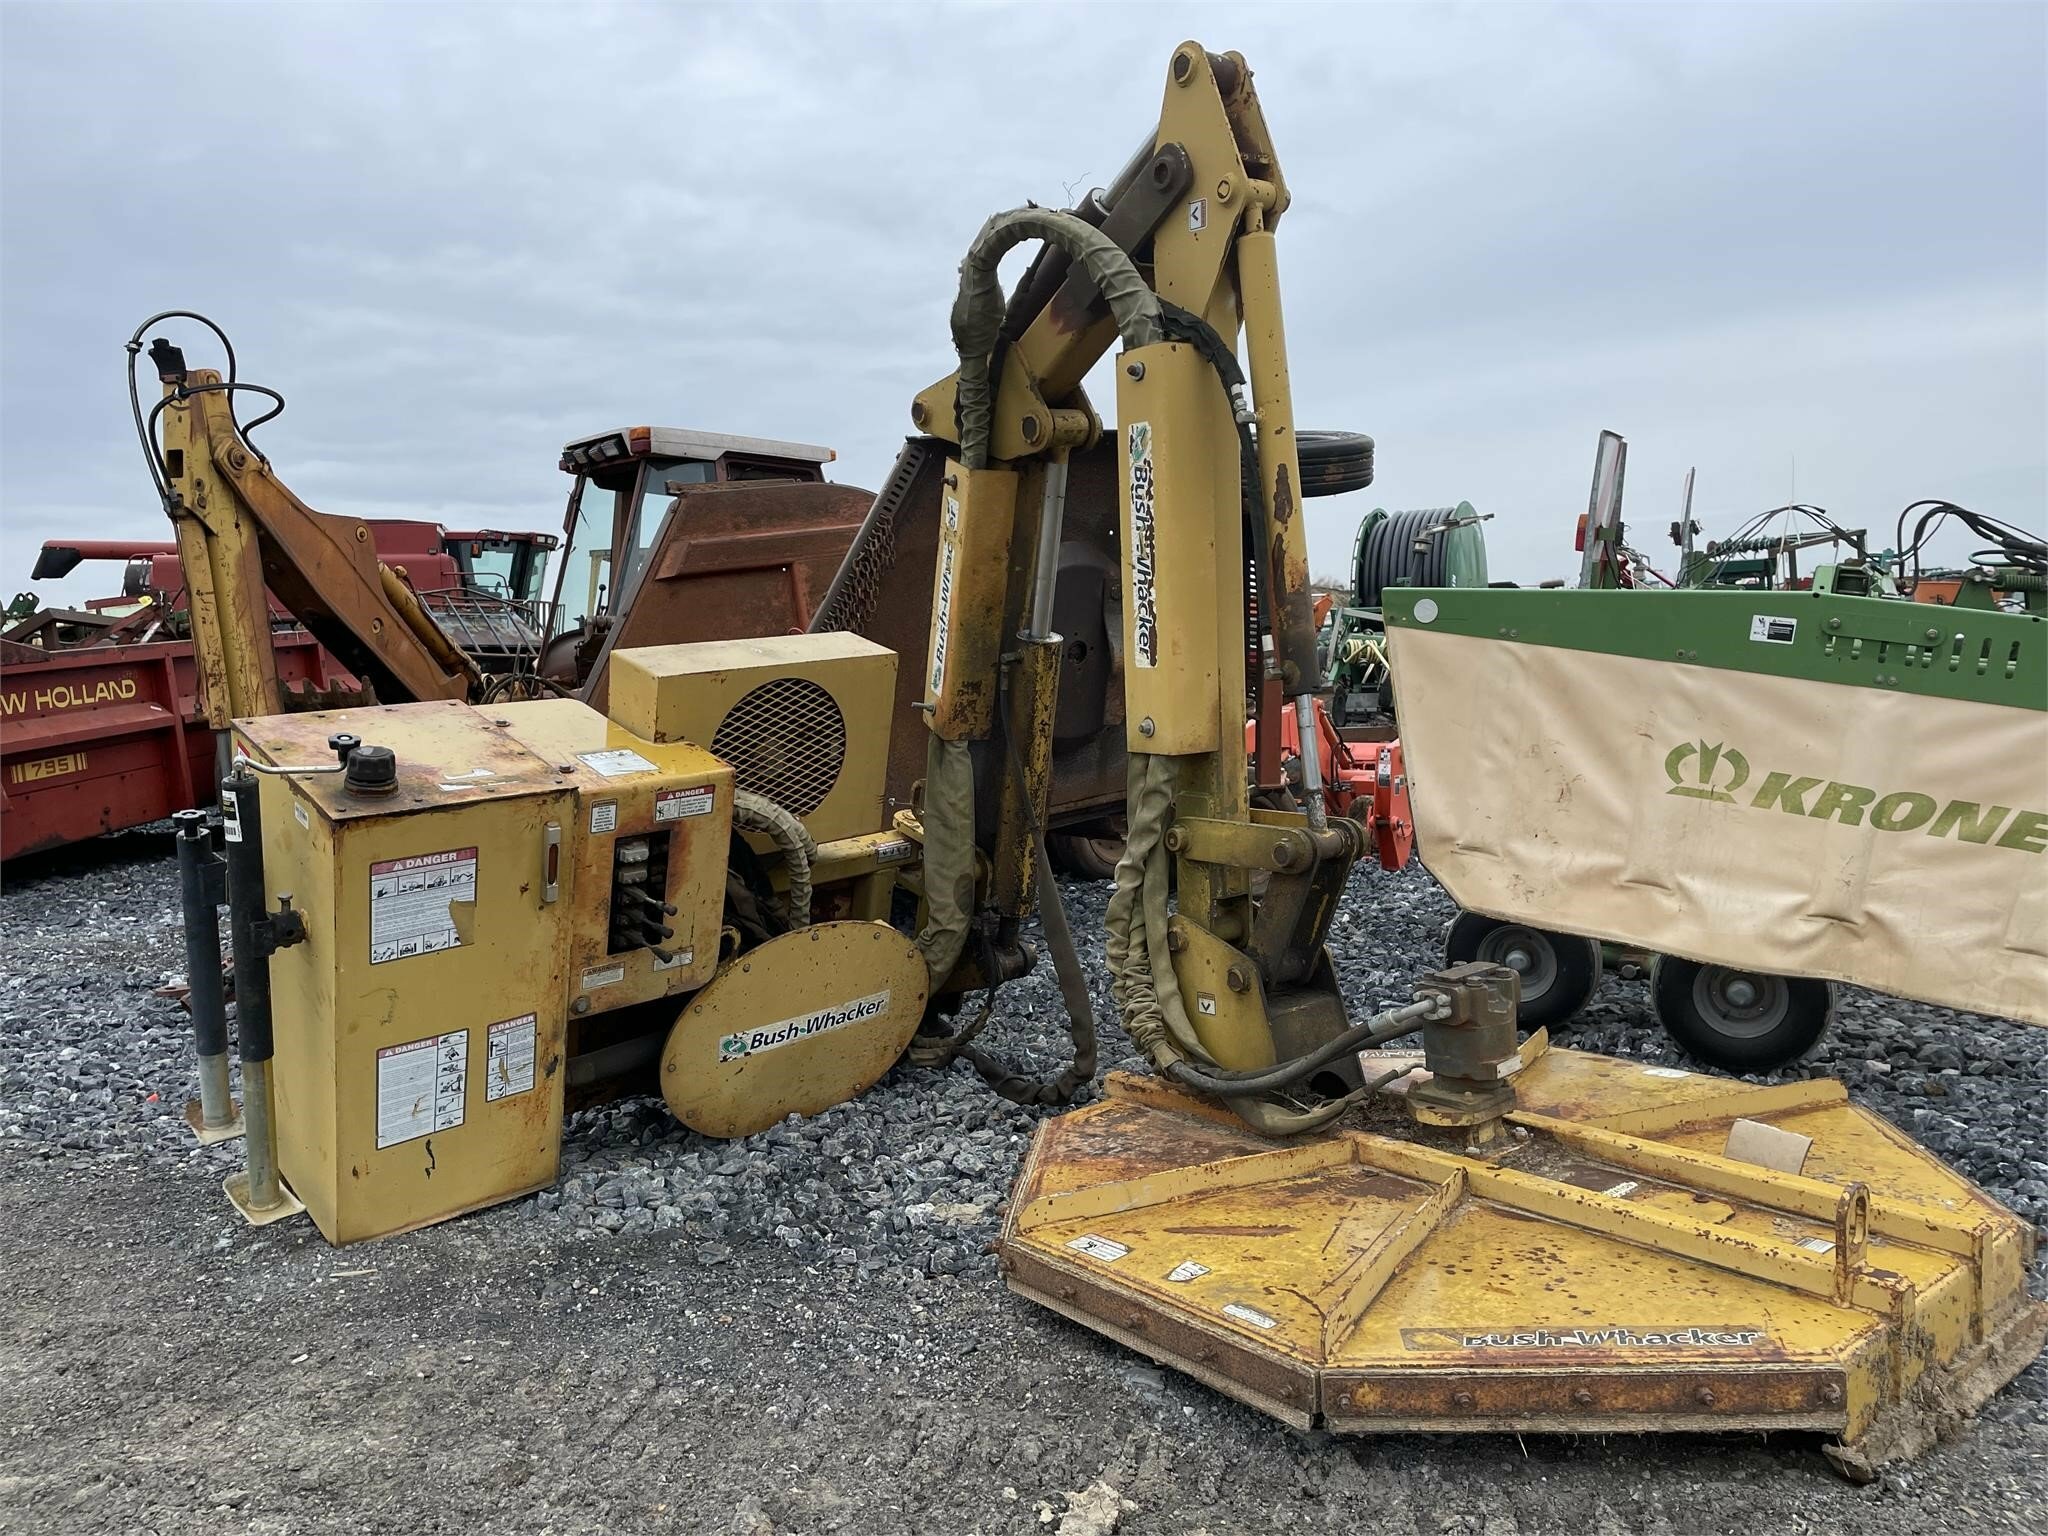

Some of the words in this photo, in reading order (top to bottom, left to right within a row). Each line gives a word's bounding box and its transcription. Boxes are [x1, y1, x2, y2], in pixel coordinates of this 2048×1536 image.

[35, 679, 136, 711] HOLLAND
[31, 757, 70, 777] 795
[675, 788, 705, 798] DANGER
[1750, 771, 2048, 854] KRONE
[406, 852, 457, 867] DANGER
[498, 1015, 534, 1031] DANGER
[395, 1040, 432, 1054] DANGER
